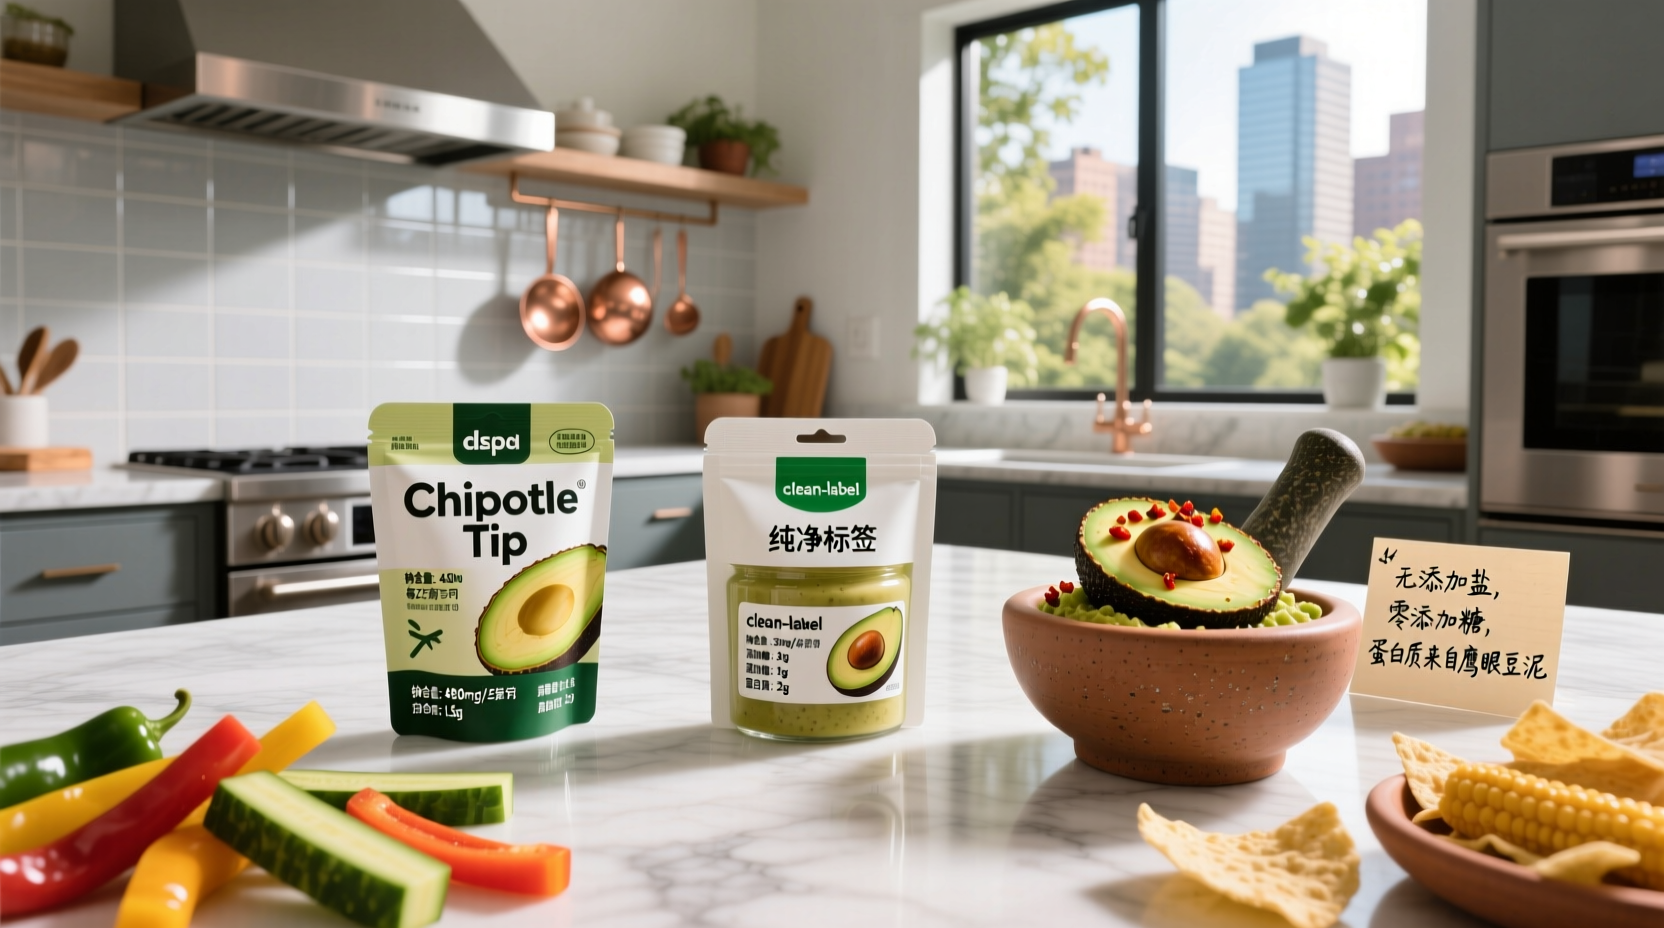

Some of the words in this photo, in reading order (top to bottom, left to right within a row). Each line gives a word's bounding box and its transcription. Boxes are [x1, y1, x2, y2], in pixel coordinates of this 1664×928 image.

[404, 480, 578, 522] Chipotle
[782, 481, 860, 496] clean-label
[462, 523, 528, 565] Tip
[768, 524, 877, 553] 纯净标签
